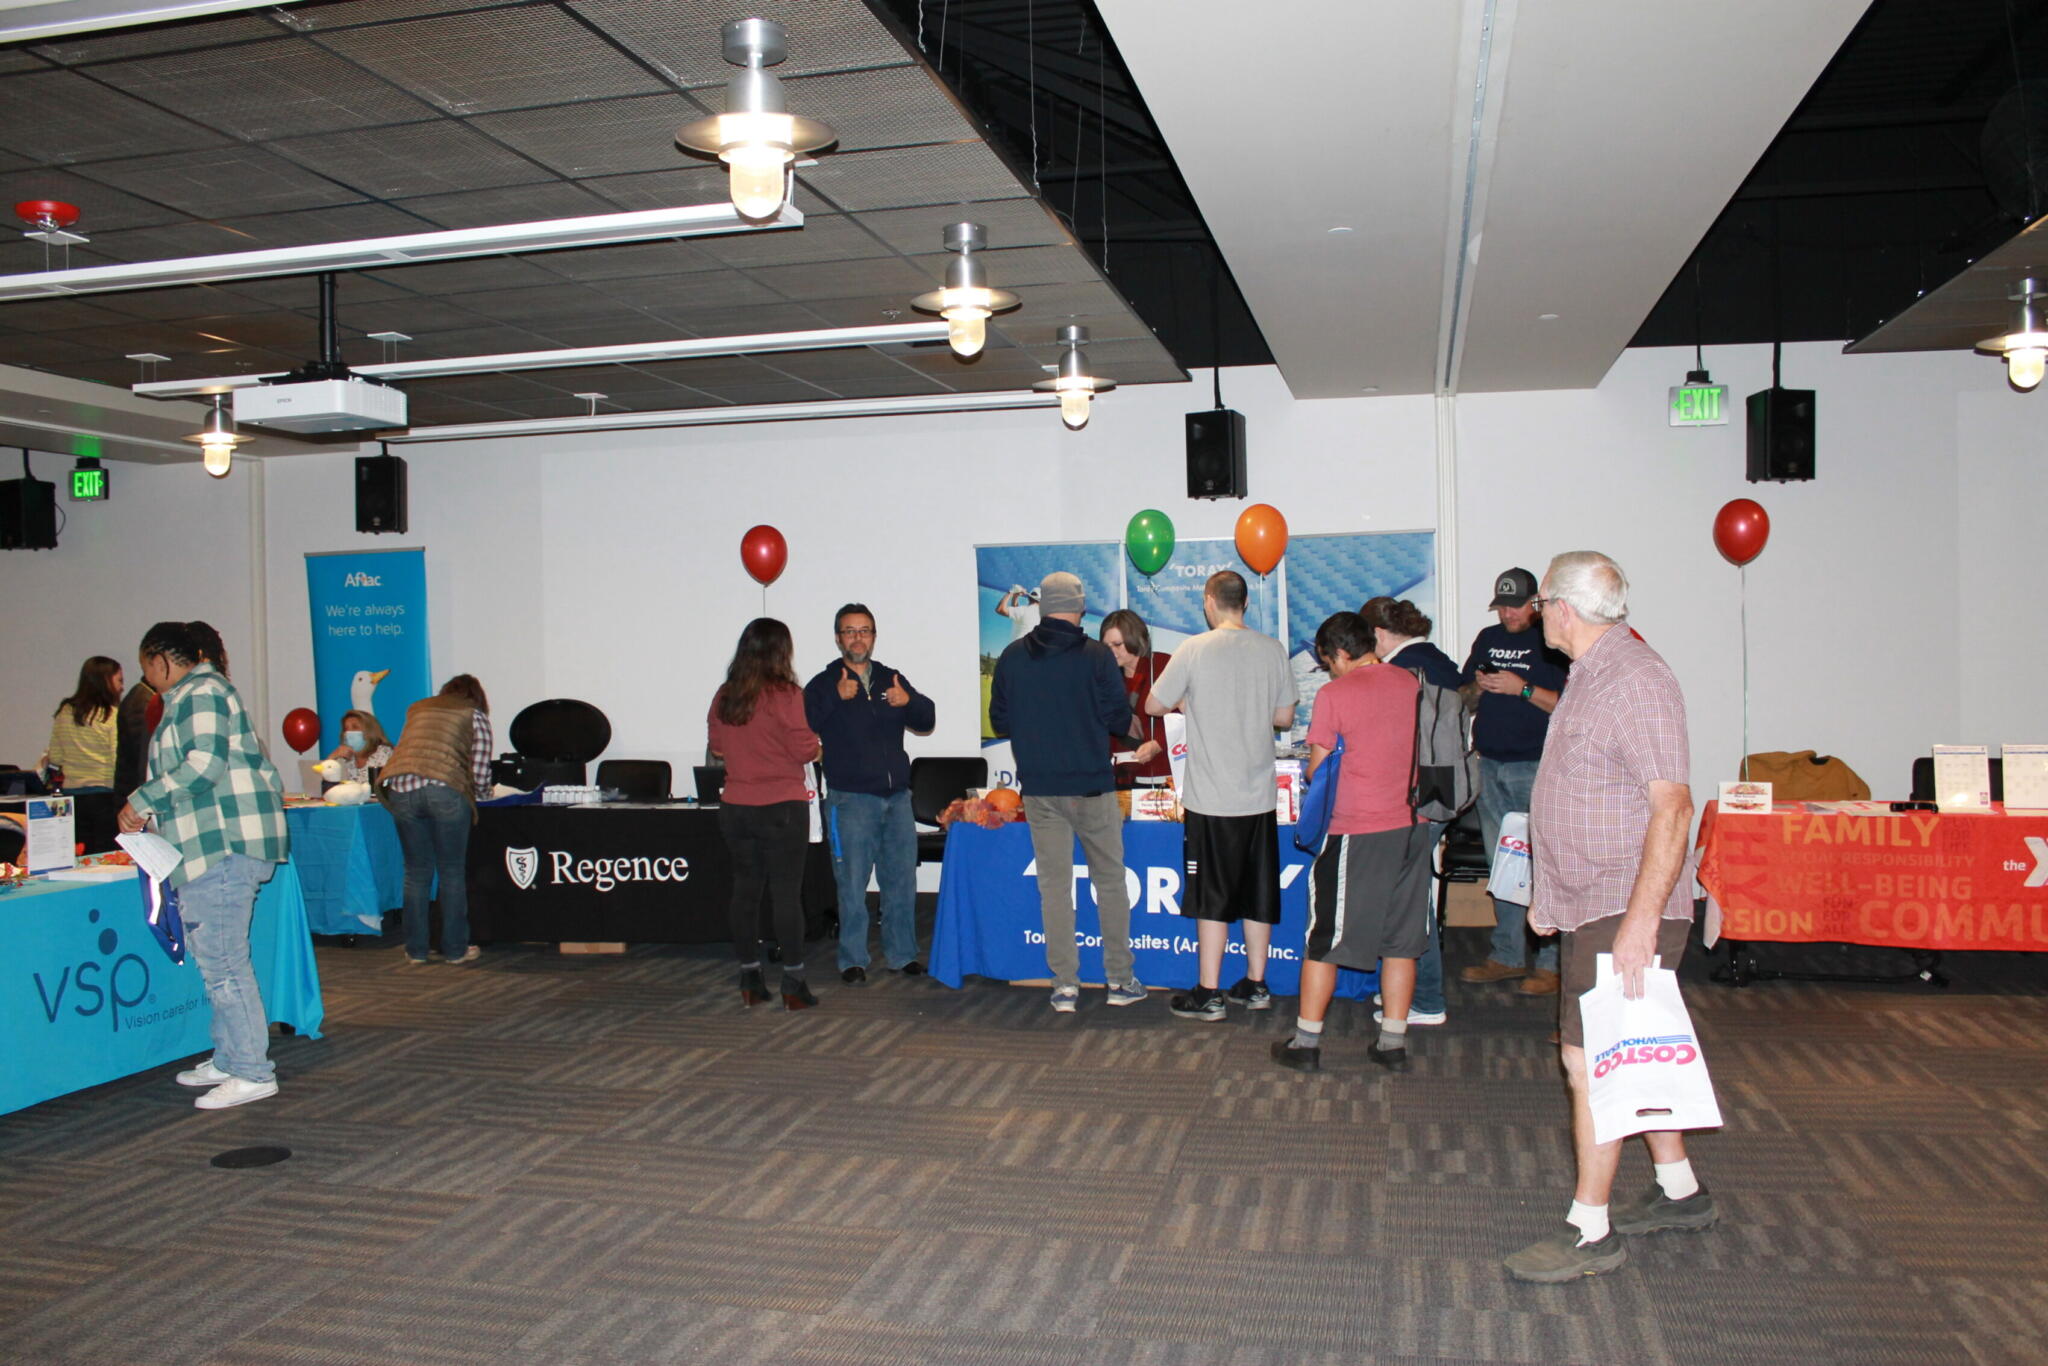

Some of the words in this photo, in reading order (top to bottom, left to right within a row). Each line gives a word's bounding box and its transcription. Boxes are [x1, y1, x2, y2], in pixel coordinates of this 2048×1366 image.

[1679, 388, 1721, 421] EXIT
[74, 471, 101, 497] EXIT
[344, 572, 382, 588] Aflac
[325, 604, 361, 617] We're
[364, 604, 406, 618] always
[328, 624, 357, 637] here
[359, 624, 373, 636] to
[375, 622, 405, 638] help.
[1782, 815, 1940, 847] FAMILY
[549, 851, 690, 892] Regence
[1841, 853, 1976, 868] RESPONSIBILITY
[2003, 859, 2027, 871] the
[1777, 871, 1973, 900] WELL-BEING
[1268, 944, 1299, 960] Inc.
[33, 953, 149, 1032] vsp
[125, 1010, 160, 1030] Vision
[162, 1004, 185, 1020] care
[1593, 1044, 1697, 1079] COSTCO
